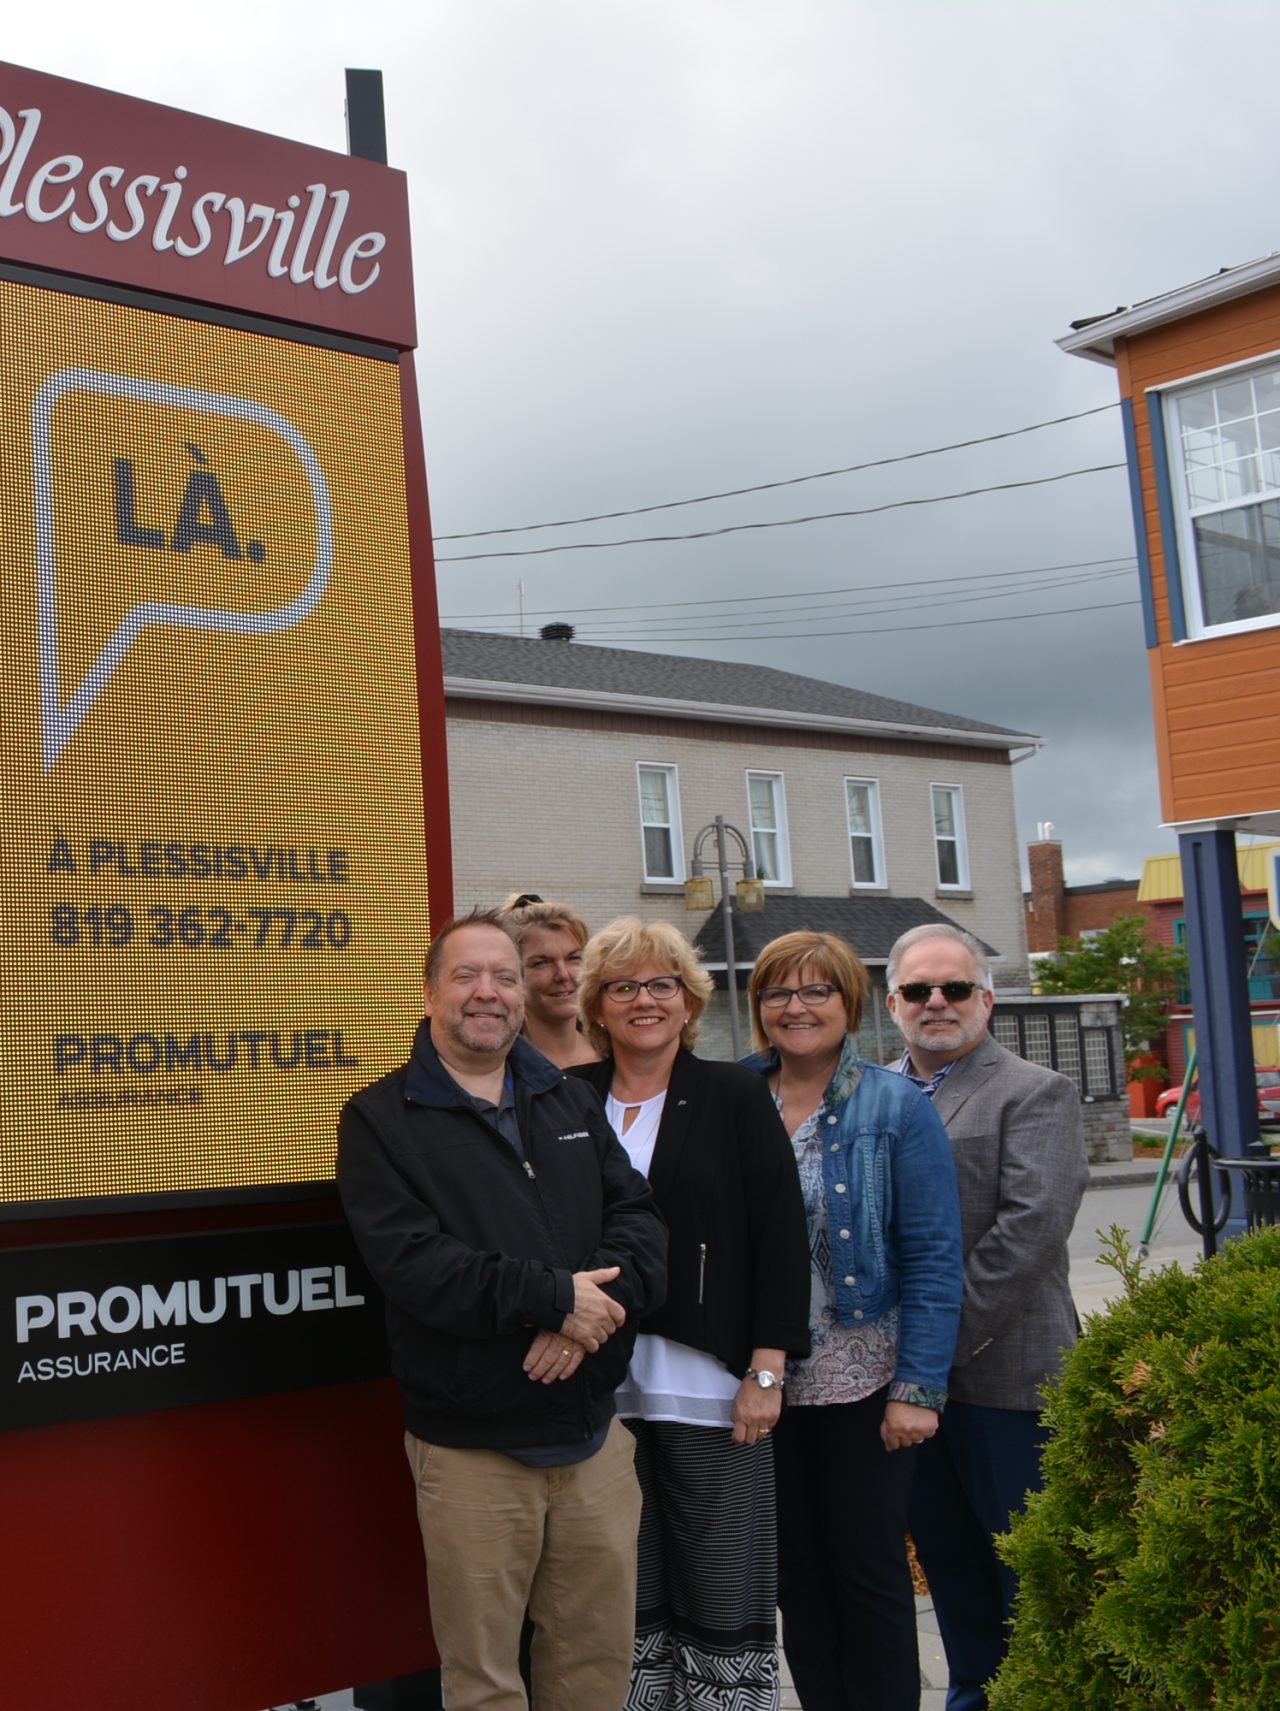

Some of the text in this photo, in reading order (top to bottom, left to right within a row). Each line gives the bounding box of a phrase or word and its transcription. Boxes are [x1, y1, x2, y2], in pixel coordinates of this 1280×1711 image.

[114, 442, 266, 564] LÀ.
[47, 825, 350, 883] À PLESSISVILLE
[50, 902, 352, 949] 819 362-7720
[54, 1029, 359, 1076] PROMUTUEL
[15, 1265, 365, 1343] PROMUTUEL
[17, 1342, 186, 1383] ASSURANCE
